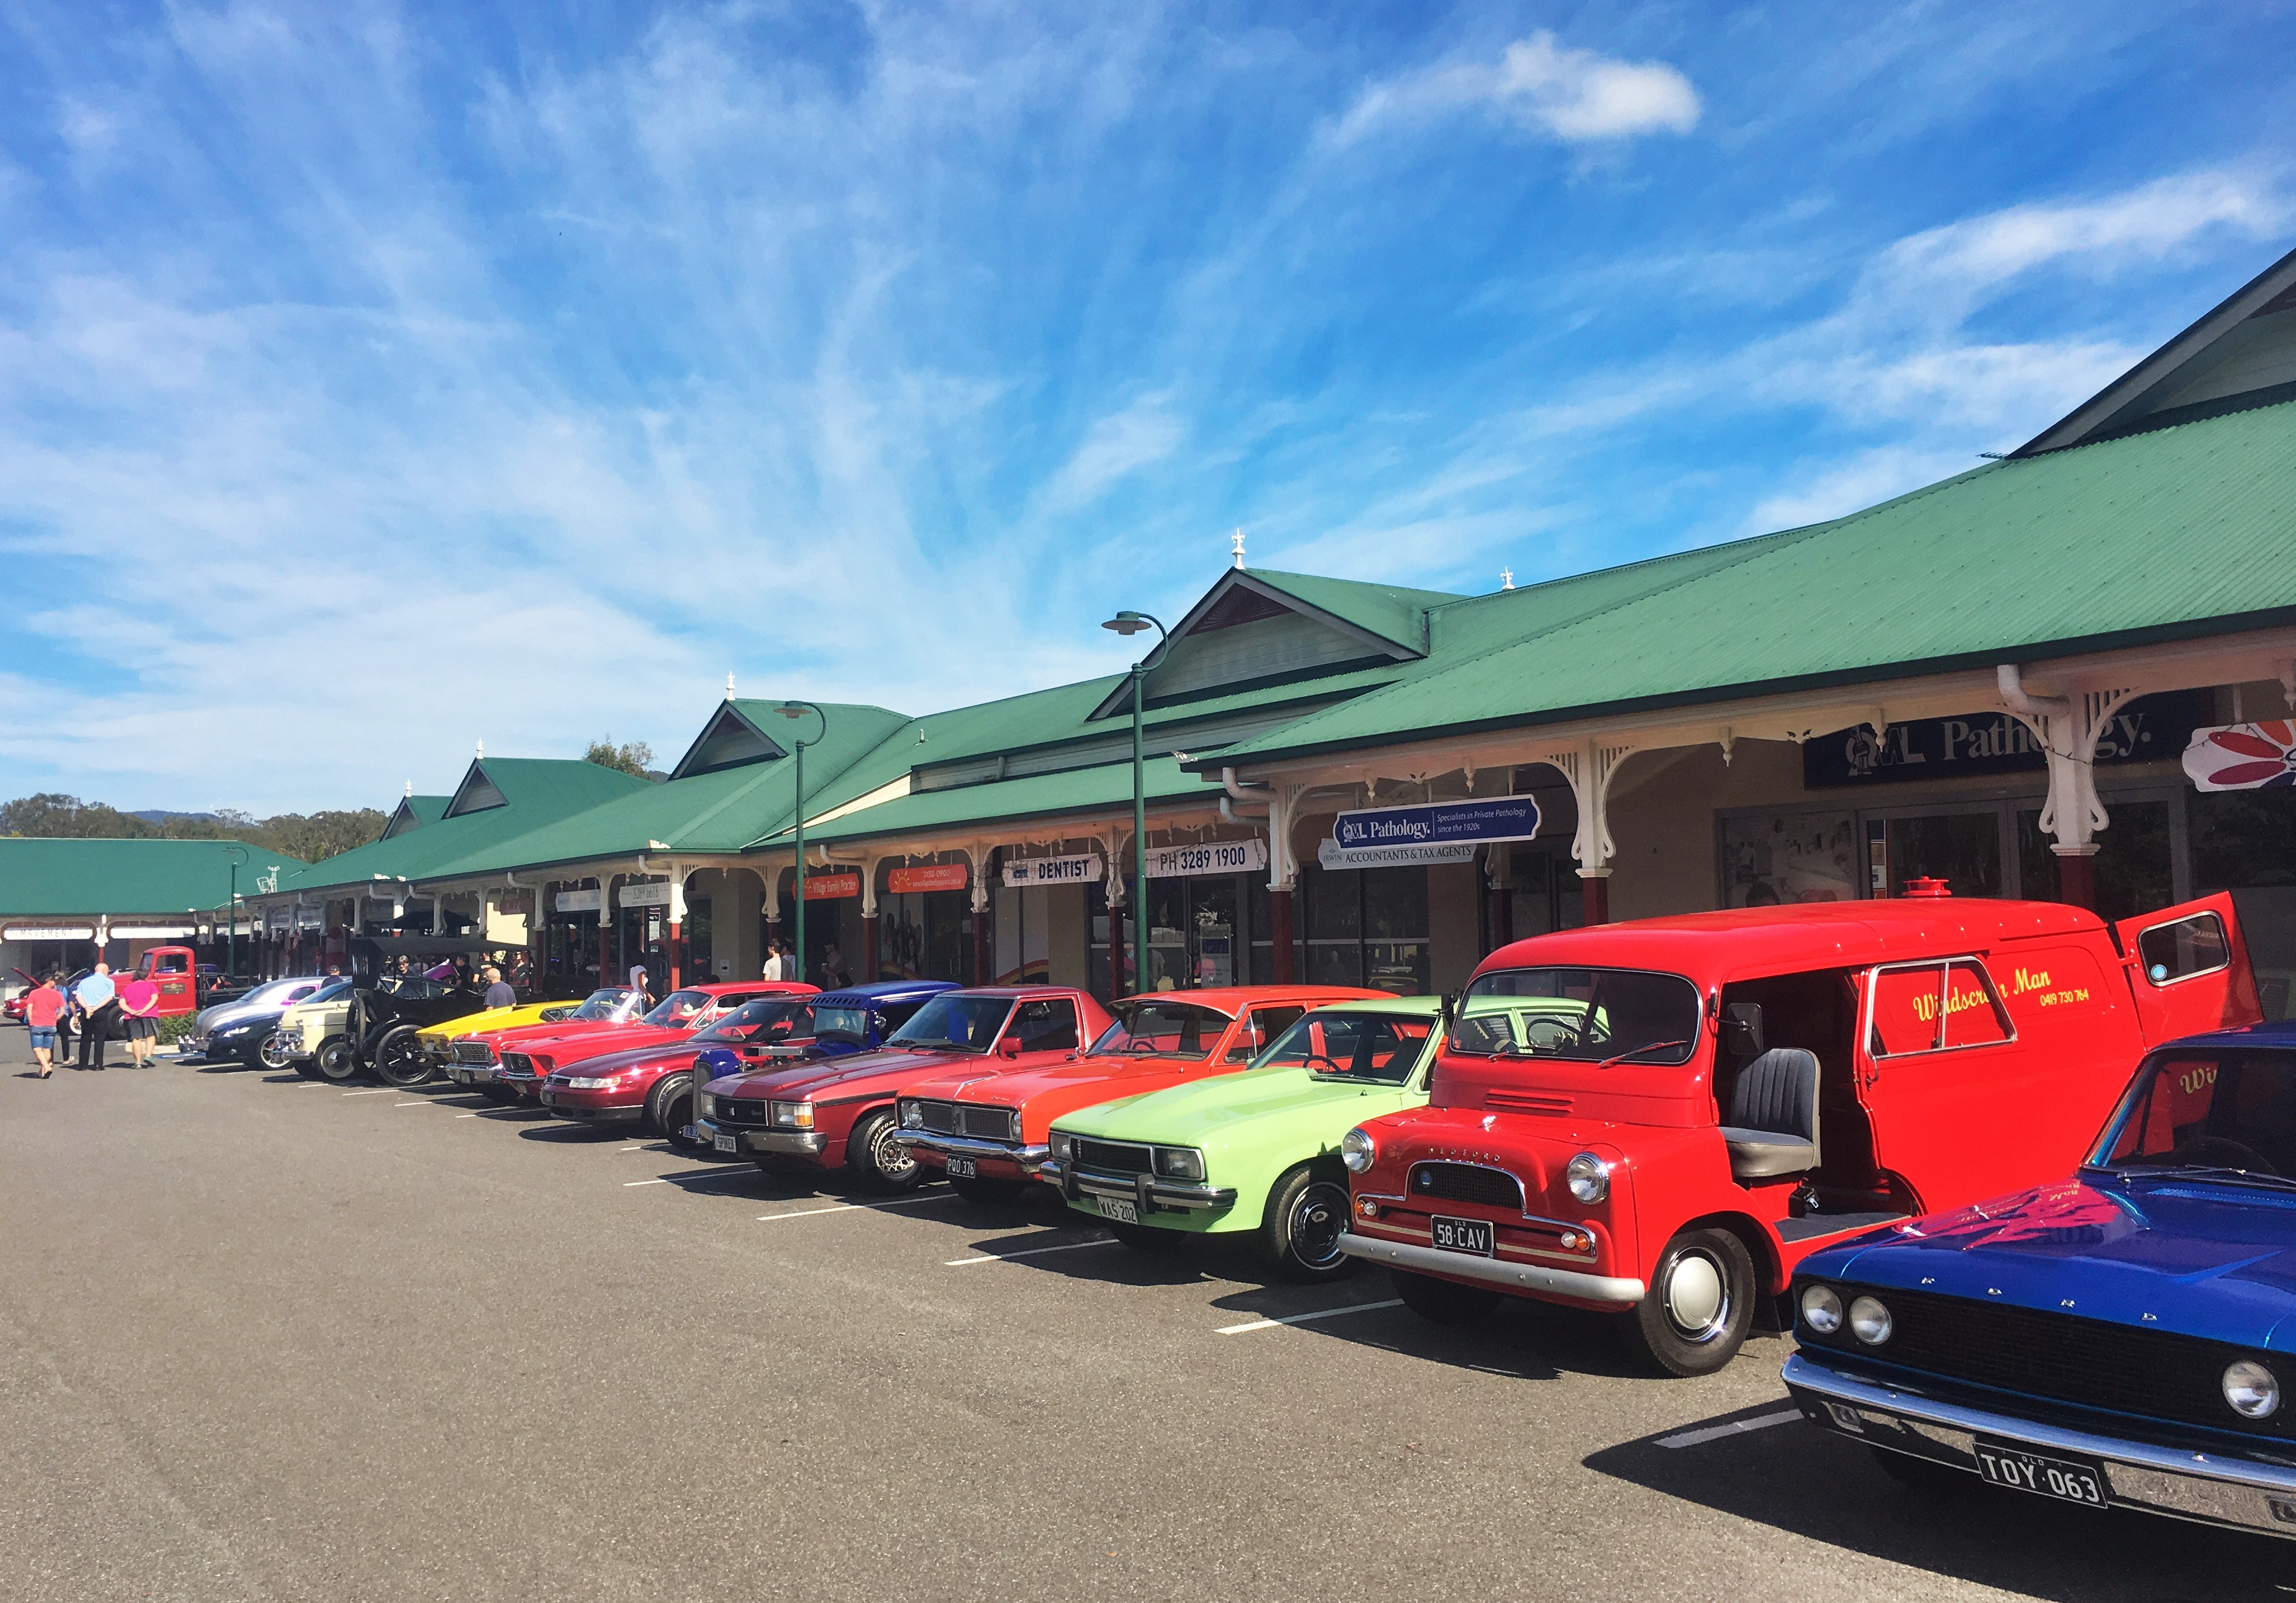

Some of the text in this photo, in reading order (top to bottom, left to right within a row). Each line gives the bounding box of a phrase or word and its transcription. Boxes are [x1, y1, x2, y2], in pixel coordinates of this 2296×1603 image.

[1941, 713, 2152, 762] Pathgy.
[1437, 812, 1466, 823] Specialists
[1473, 810, 1494, 819] Private
[1495, 807, 1527, 817] Pathology
[1369, 819, 1431, 839] Pathology.
[1463, 823, 1480, 831] 1920s
[1160, 847, 1245, 871] PH 3289 1900
[1345, 845, 1471, 863] ACCOUNTANTS & TAX AGENTS
[1039, 860, 1089, 879] DENTIST
[813, 879, 856, 895] Village Family Practice
[2014, 967, 2051, 995] Man
[2058, 990, 2073, 1004] 730
[2076, 988, 2089, 1001] 764
[2021, 1455, 2045, 1466] QLD
